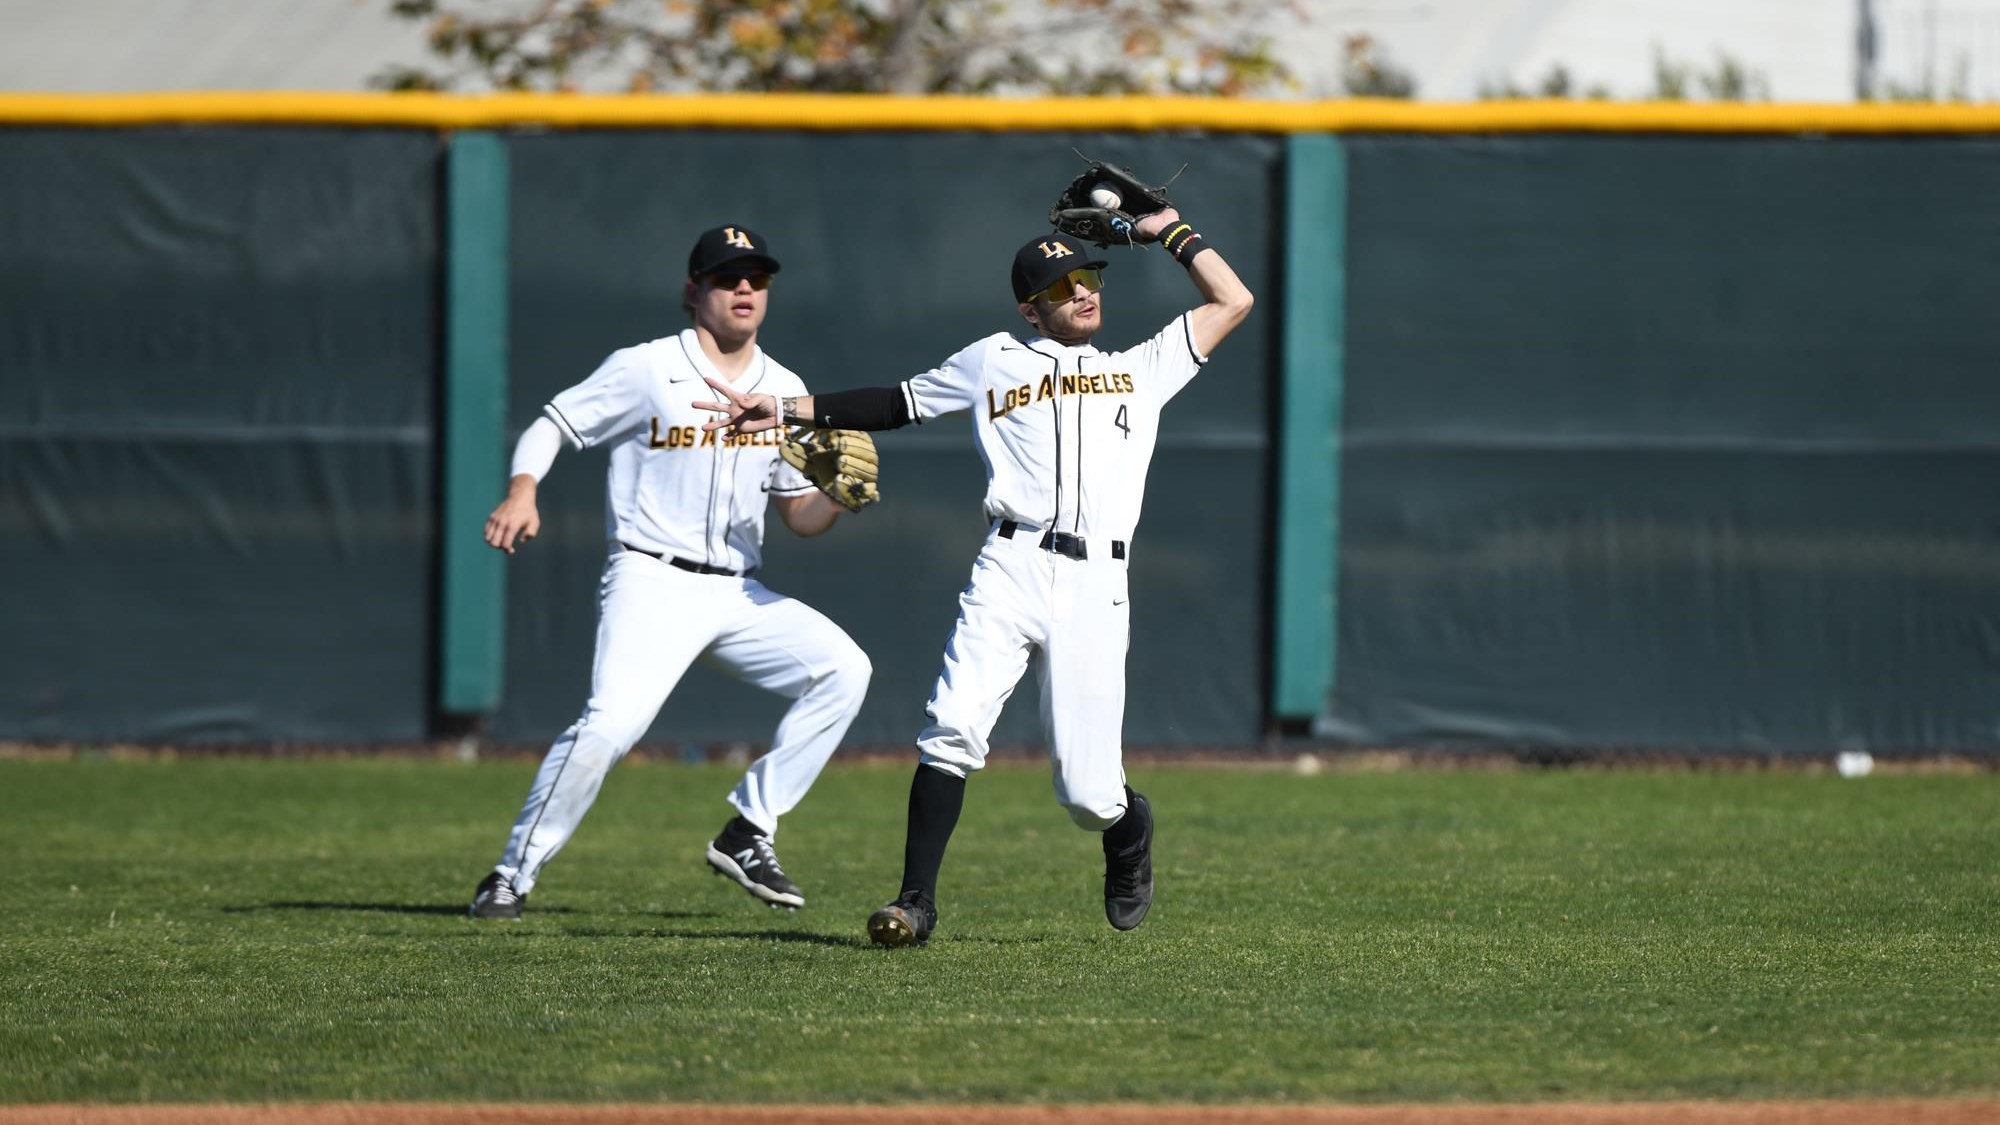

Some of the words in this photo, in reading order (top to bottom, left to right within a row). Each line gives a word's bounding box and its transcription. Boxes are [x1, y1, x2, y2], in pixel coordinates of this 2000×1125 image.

[723, 227, 754, 249] LA
[1038, 241, 1074, 259] LA
[987, 383, 1031, 423] LOS
[1036, 372, 1136, 403] ANGELES
[650, 415, 696, 449] LOS
[1114, 403, 1131, 440] 4
